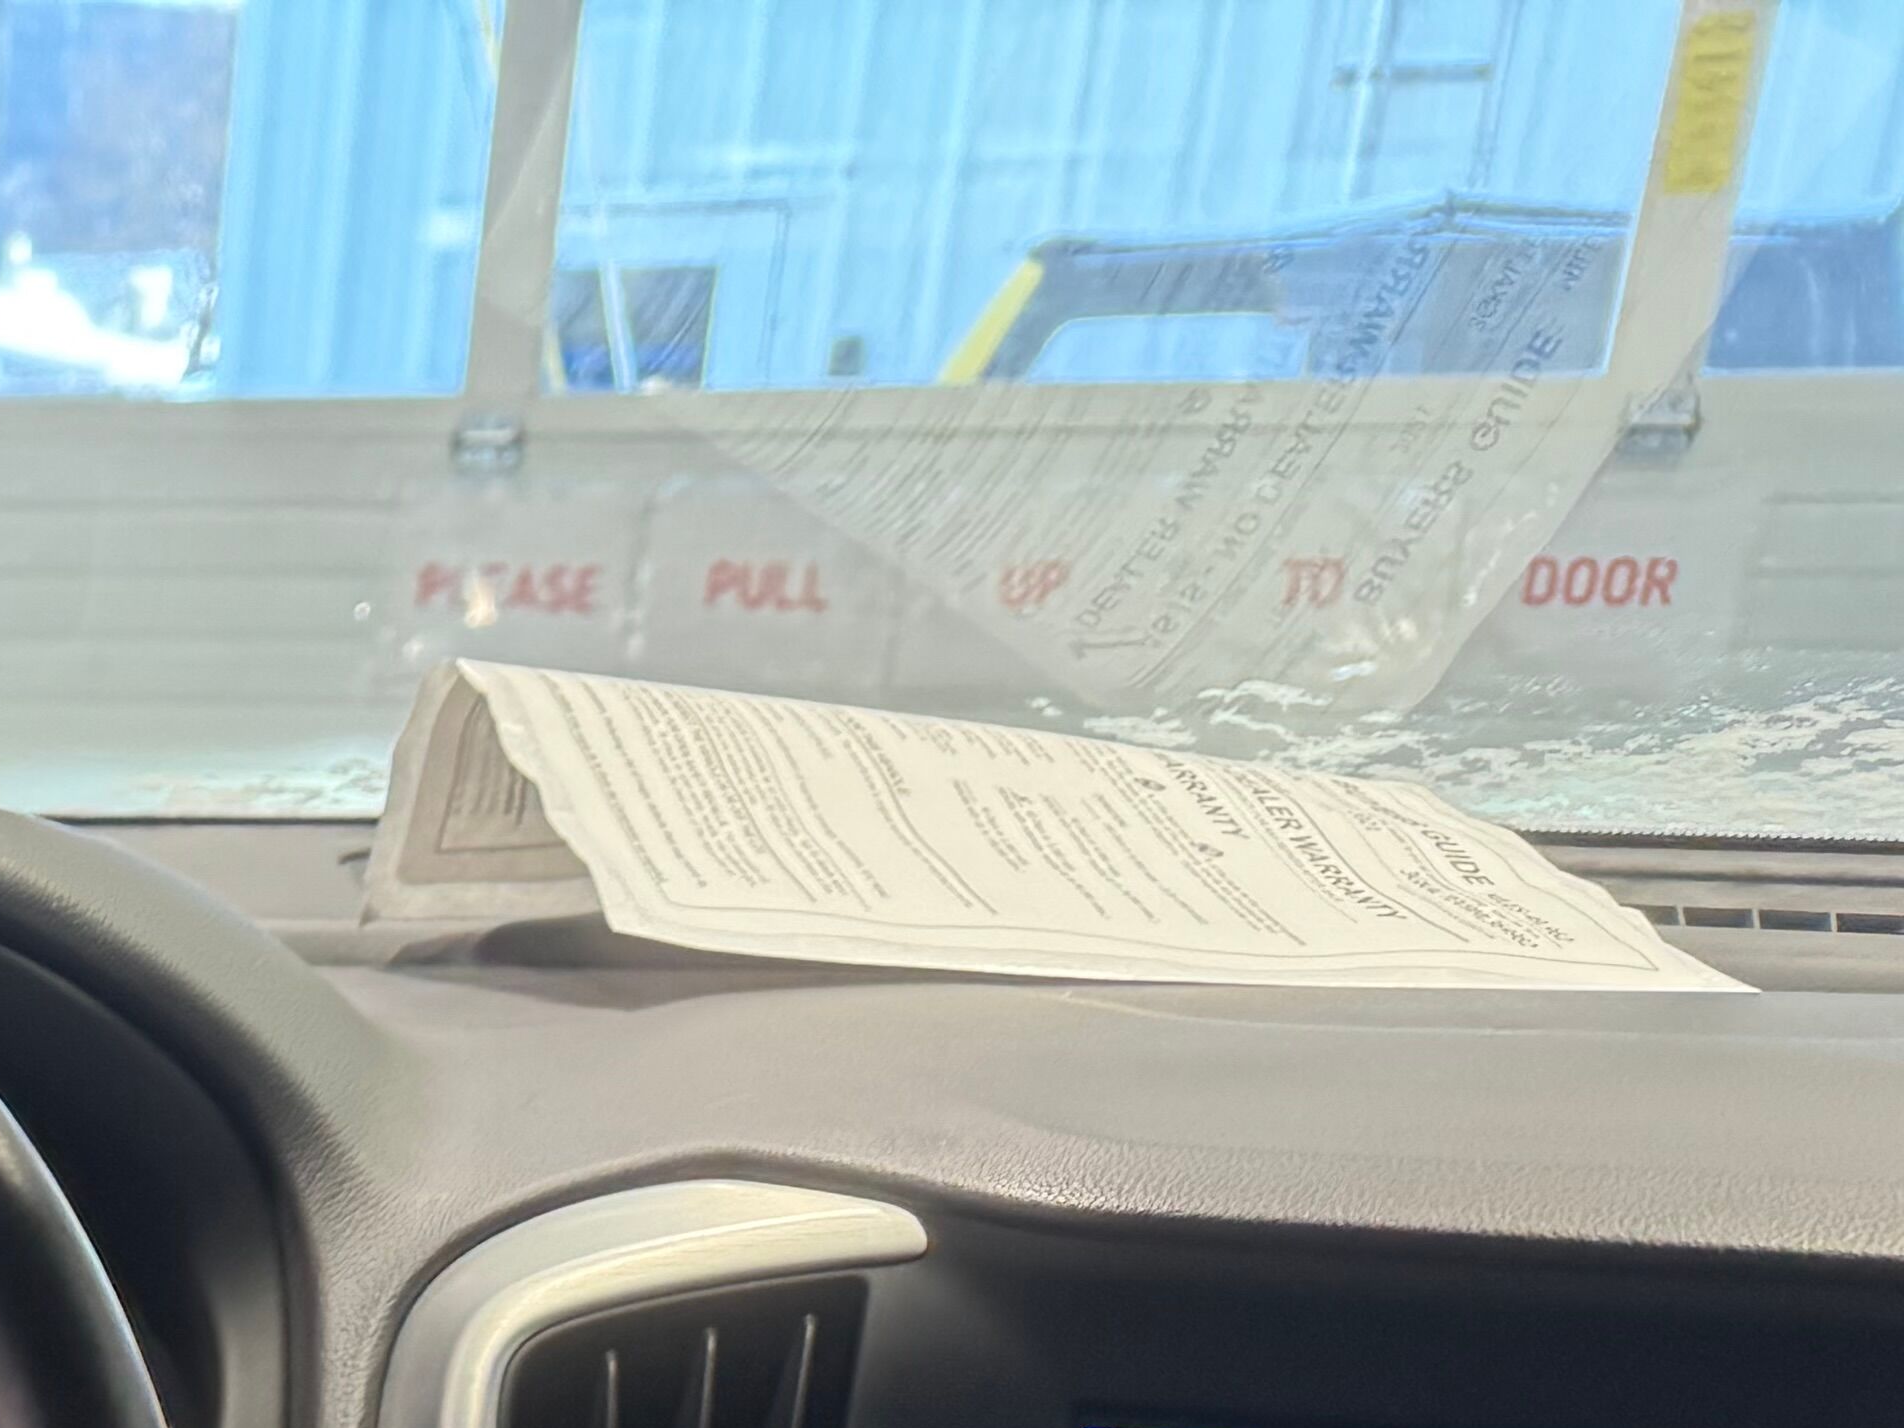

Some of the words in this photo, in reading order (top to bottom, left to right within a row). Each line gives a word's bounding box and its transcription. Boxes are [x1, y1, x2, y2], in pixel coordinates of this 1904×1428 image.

[415, 559, 602, 614] PASE
[704, 557, 830, 612] PULL
[999, 558, 1071, 611] UP
[1282, 557, 1347, 608] TO
[1520, 553, 1679, 610] DOOR
[1290, 834, 1408, 921] WARRANTY
[1421, 828, 1495, 887] GUIDE
